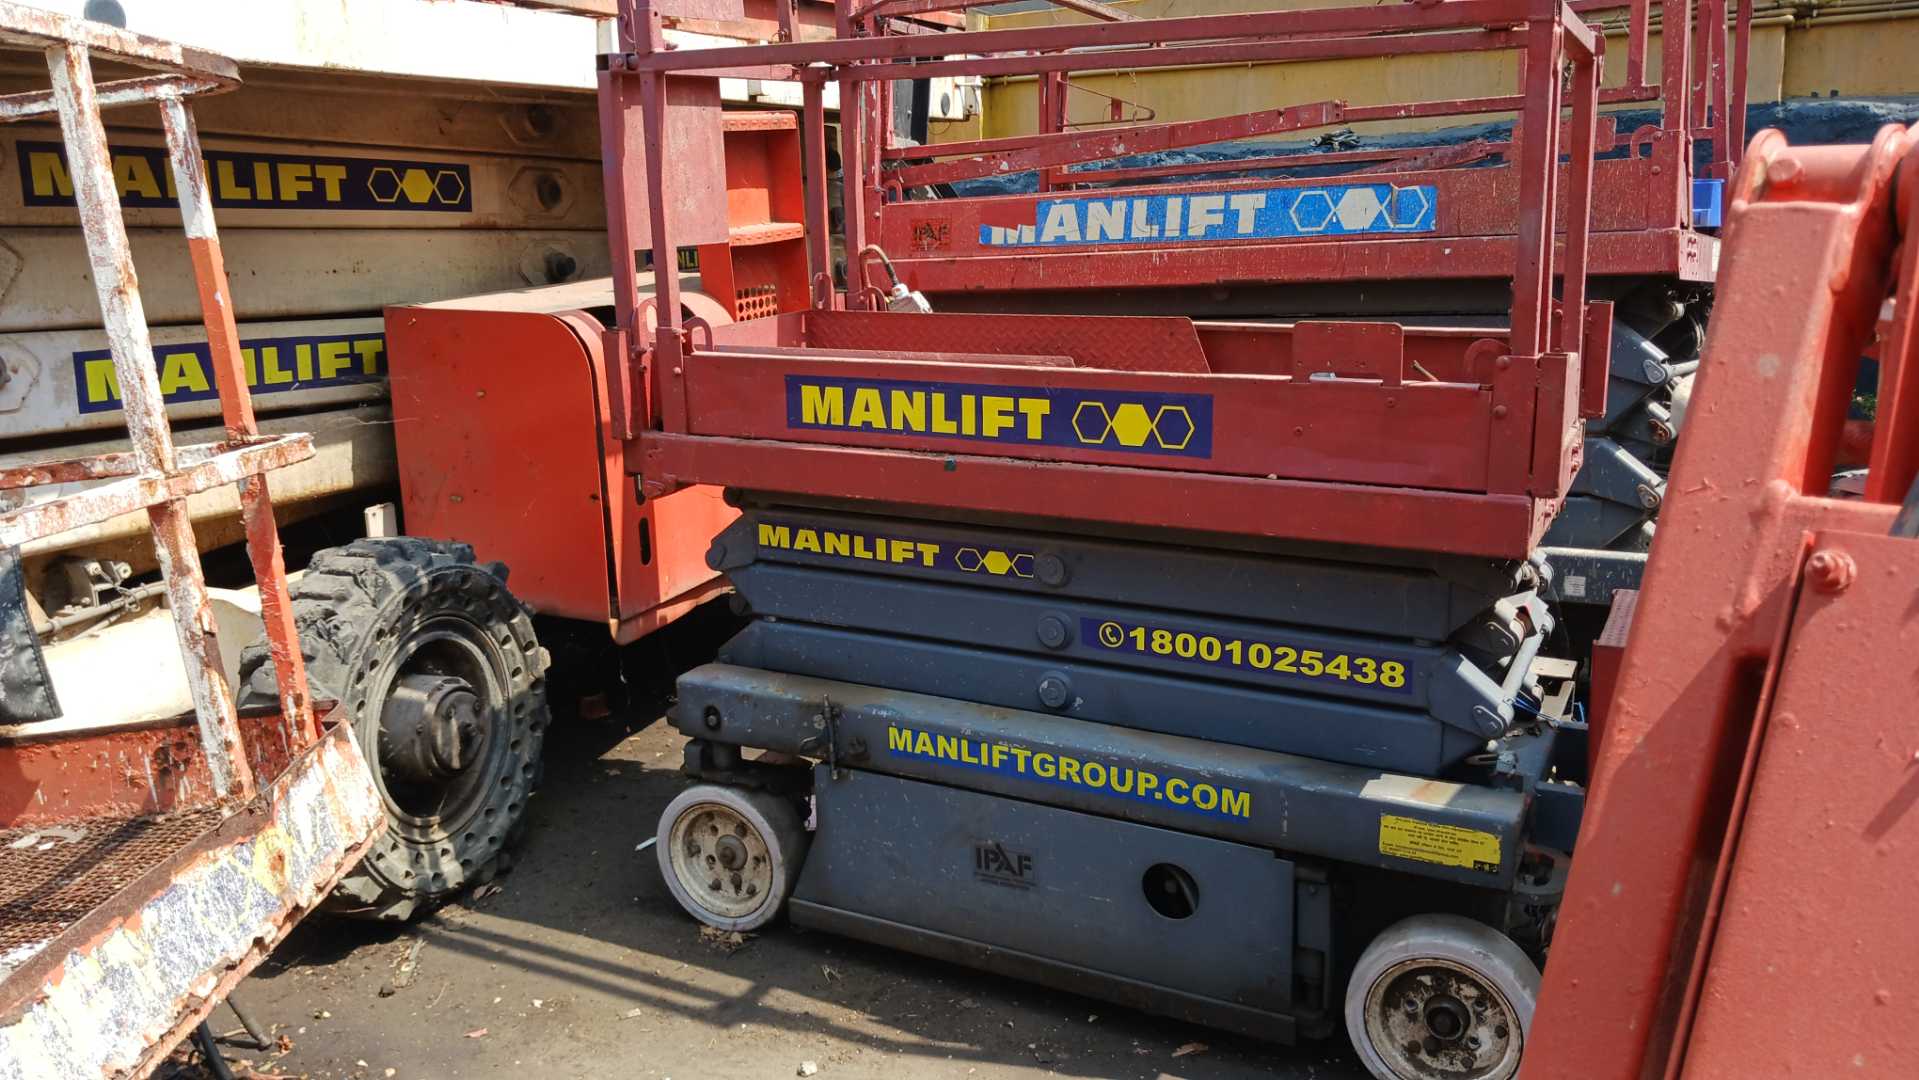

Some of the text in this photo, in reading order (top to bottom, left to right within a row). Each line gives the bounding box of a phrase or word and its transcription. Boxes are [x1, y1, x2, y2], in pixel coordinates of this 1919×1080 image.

[801, 385, 1050, 440] MANLIFT
[758, 523, 940, 567] MANLIFT
[1129, 626, 1406, 688] 18001025438
[888, 726, 1251, 818] MANLIFTGROUP.COM
[975, 842, 1032, 876] IPAF
